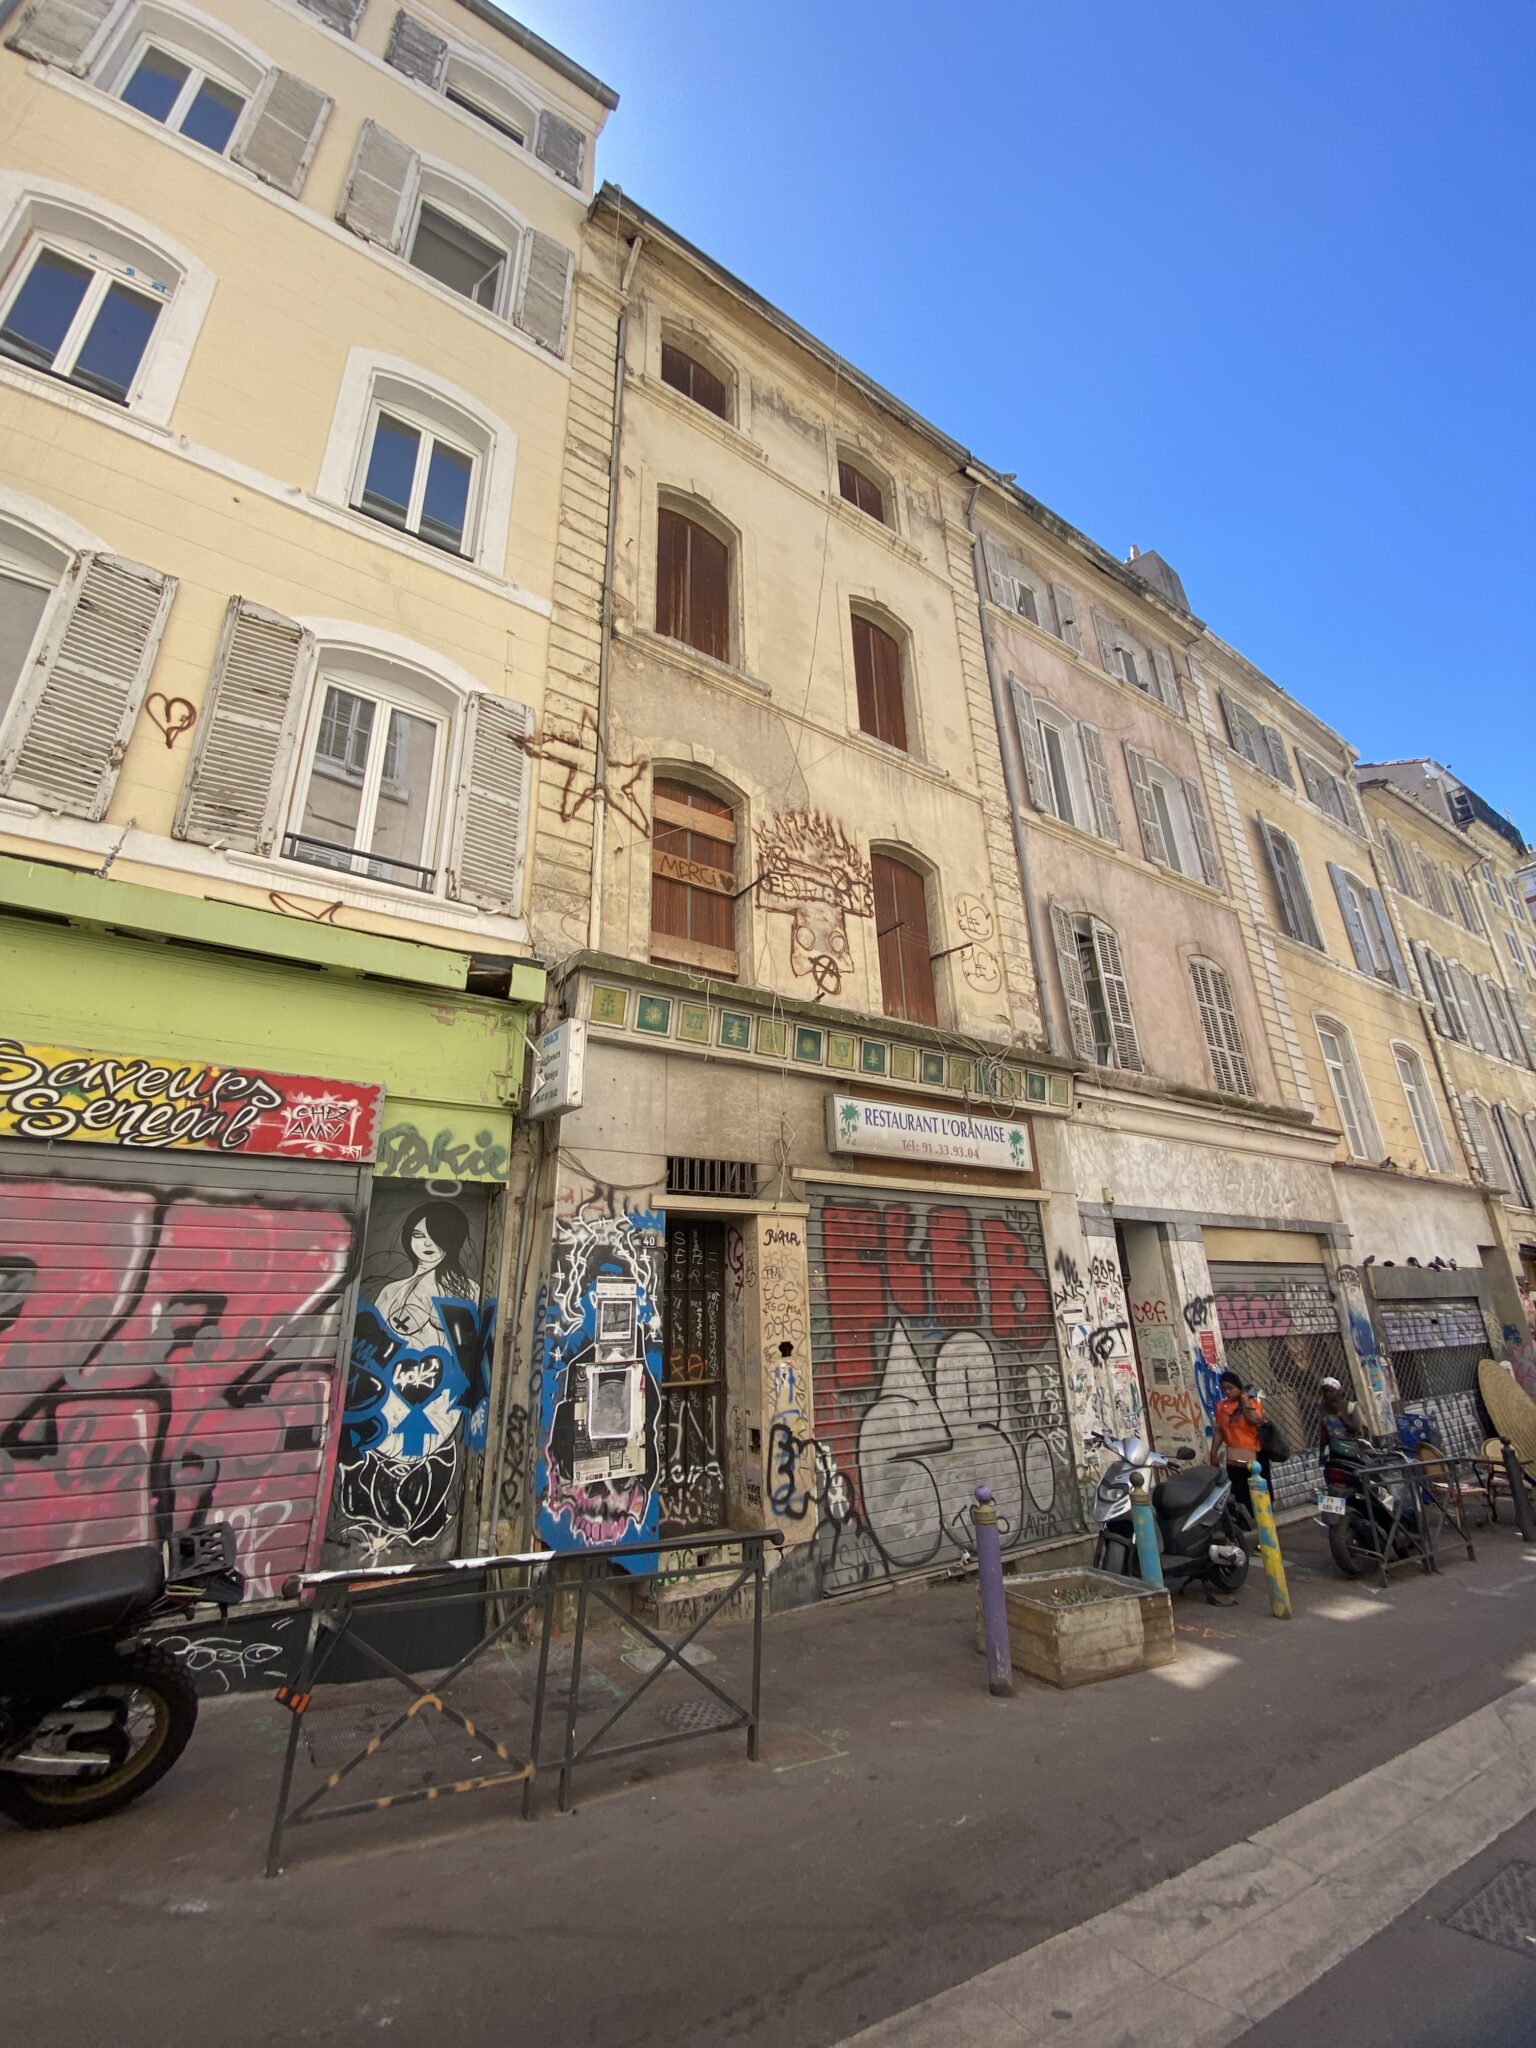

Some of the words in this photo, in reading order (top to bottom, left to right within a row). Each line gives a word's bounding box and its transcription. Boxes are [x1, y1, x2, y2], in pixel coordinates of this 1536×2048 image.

[543, 1029, 560, 1048] SNACK
[284, 1120, 345, 1141] AMY
[864, 1107, 939, 1134] RESTAURANT
[941, 1118, 1006, 1144] L'ORANAISE
[643, 1236, 656, 1246] 40
